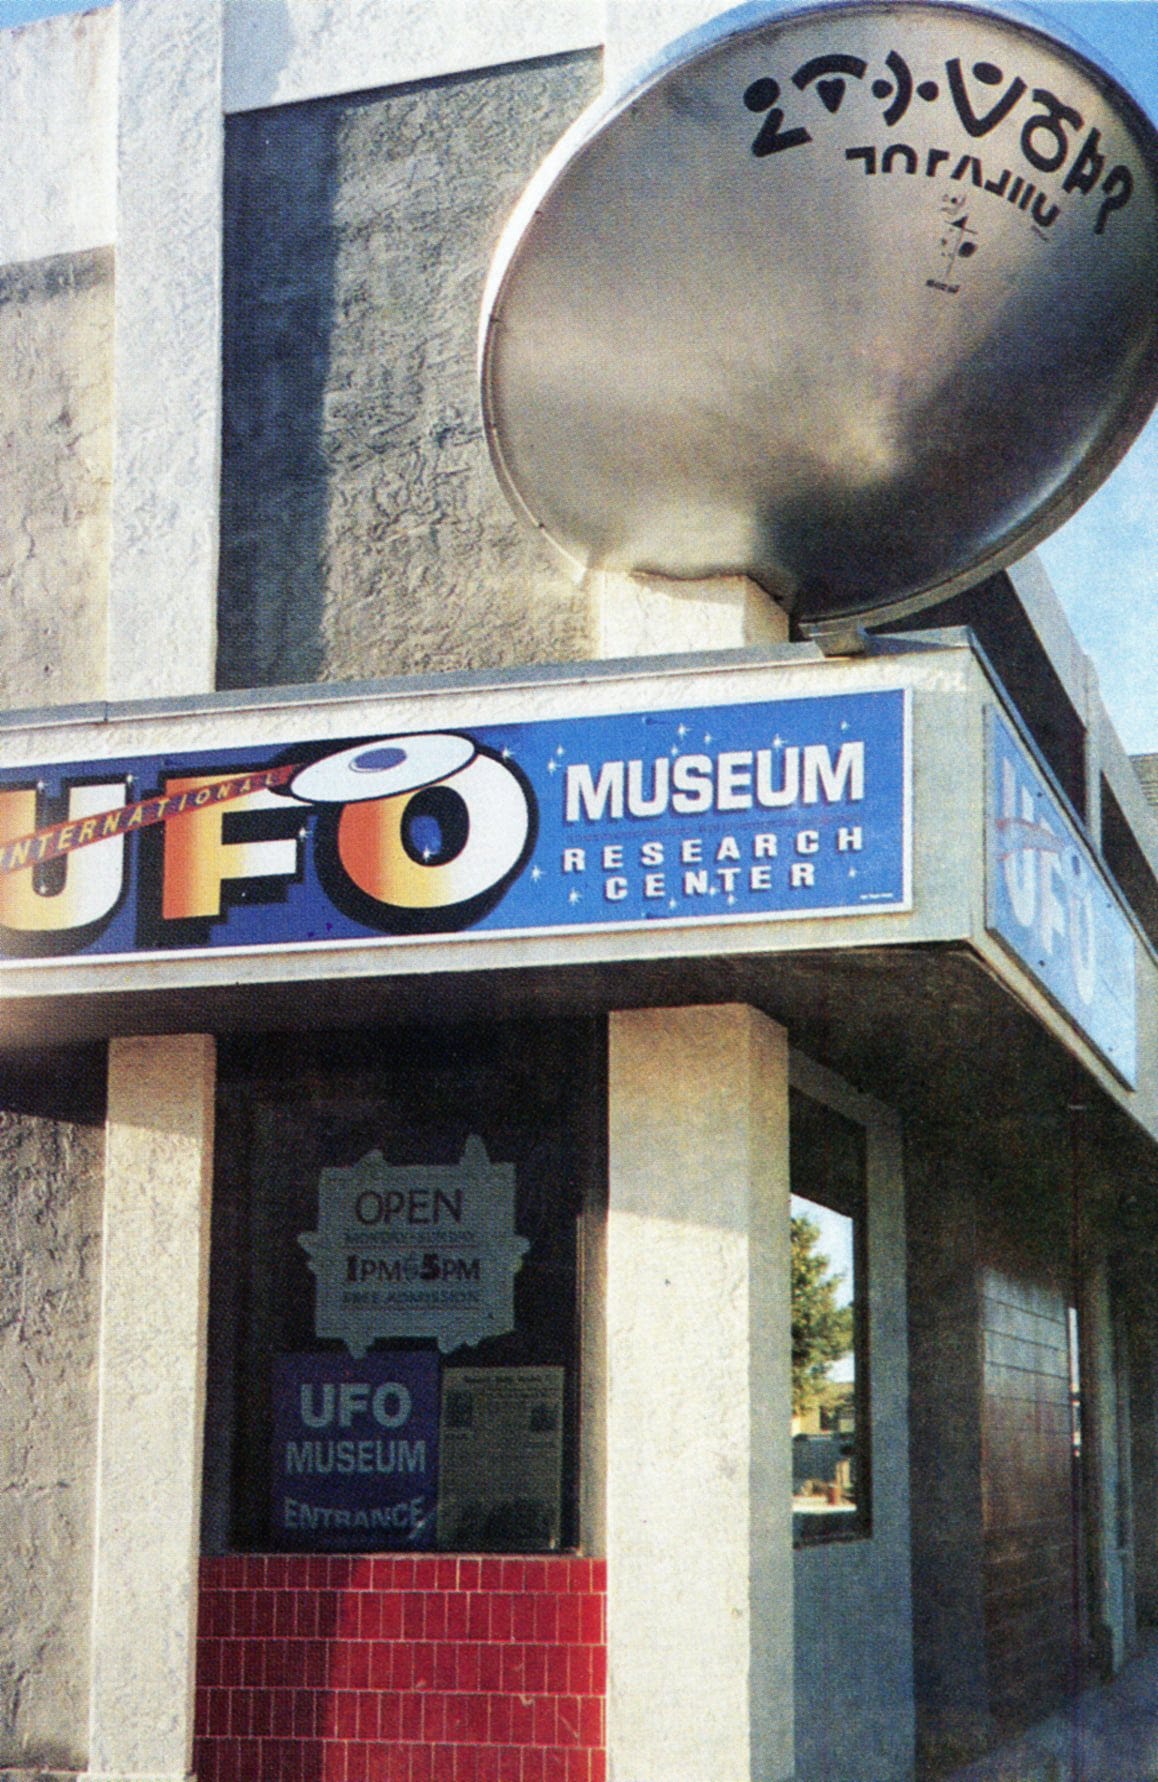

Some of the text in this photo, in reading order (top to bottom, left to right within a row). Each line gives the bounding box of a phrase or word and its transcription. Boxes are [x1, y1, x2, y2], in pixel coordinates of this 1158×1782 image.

[565, 741, 865, 822] MUSEUM
[0, 772, 273, 868] INTERNATIONAL
[0, 750, 530, 932] UFO
[563, 826, 863, 872] RESEARCH
[605, 862, 815, 900] CENTER
[1003, 756, 1097, 1005] UFO
[355, 1189, 464, 1225] OPEN
[346, 1254, 400, 1281] 1PM
[419, 1253, 481, 1281] 5PM
[300, 1382, 412, 1428] UFO
[286, 1440, 426, 1474] MUSEUM
[284, 1497, 426, 1529] ENTRANCE
